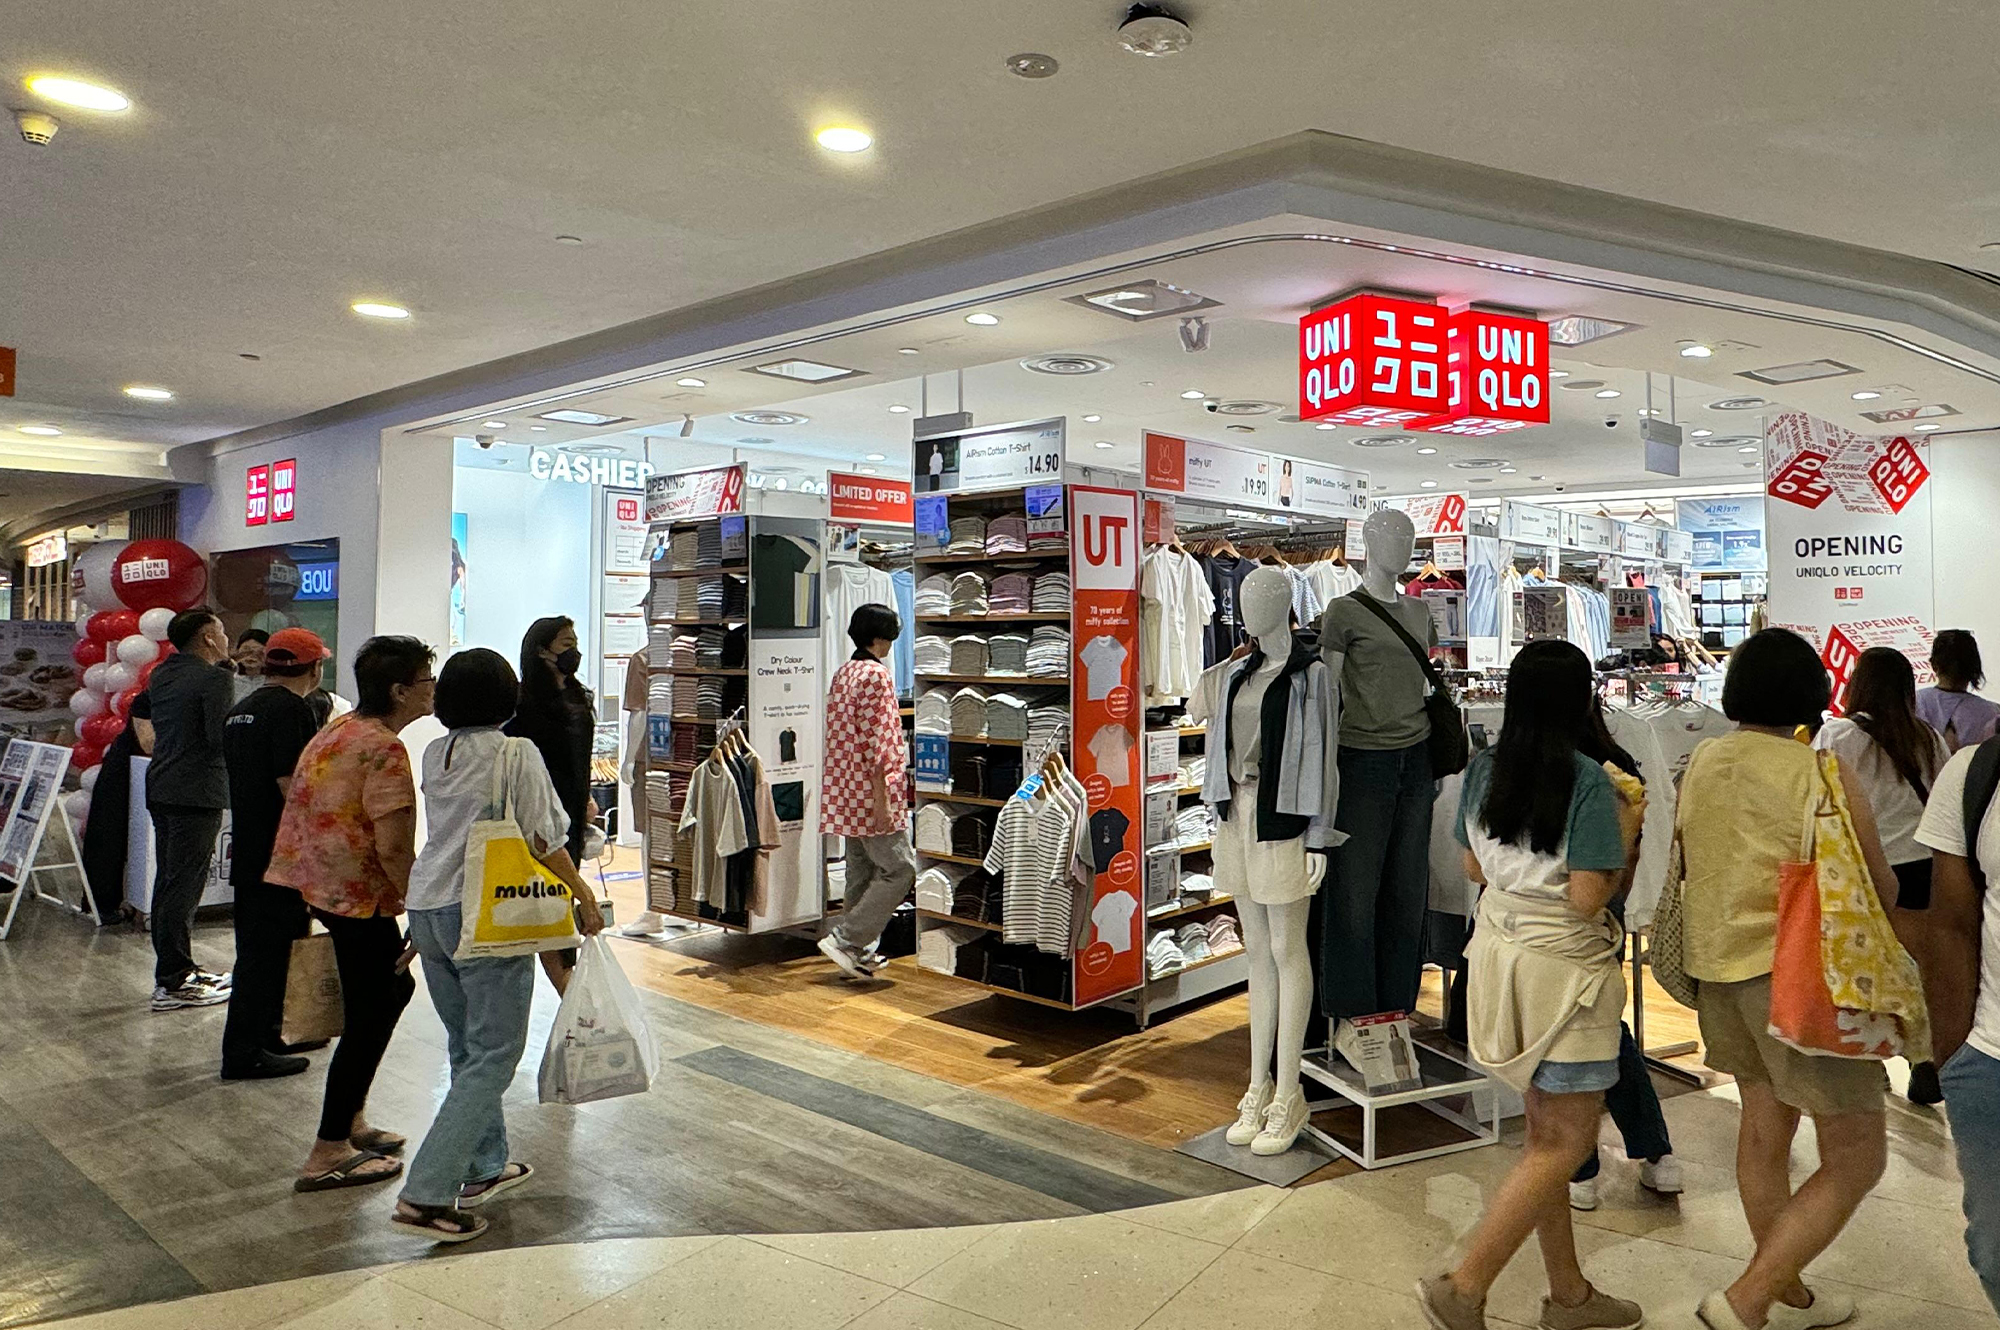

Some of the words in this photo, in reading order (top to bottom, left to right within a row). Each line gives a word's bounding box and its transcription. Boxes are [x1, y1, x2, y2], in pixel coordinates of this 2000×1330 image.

[1305, 313, 1350, 360] UNI
[1373, 310, 1438, 354] ユニ
[1478, 325, 1535, 367] UNI
[1305, 357, 1355, 409] QLO
[1371, 356, 1438, 398] クロ
[1478, 368, 1540, 411] QLO
[987, 446, 1007, 456] Cotton
[530, 451, 655, 488] CASHIER
[1890, 441, 1921, 485] UNI
[249, 473, 267, 495] ユニ
[274, 468, 292, 491] UNI
[646, 475, 685, 493] OPENING
[1776, 457, 1823, 494] QLO
[1876, 461, 1907, 503] QLO
[274, 492, 293, 517] QLO
[656, 496, 691, 514] OPENING
[832, 484, 872, 501] LIMITED
[875, 488, 907, 505] OFFER
[619, 511, 635, 519] QLO
[1704, 504, 1741, 514] AIRism
[1083, 514, 1128, 567] UT
[1795, 534, 1903, 558] OPENING
[146, 570, 166, 578] QLO
[1796, 566, 1839, 579] UNIQLO
[1843, 564, 1903, 577] VELOCITY
[1853, 616, 1920, 631] OPENING
[757, 667, 776, 676] Crew
[777, 667, 792, 675] Neck
[771, 656, 783, 666] Dry
[784, 655, 804, 664] Colour
